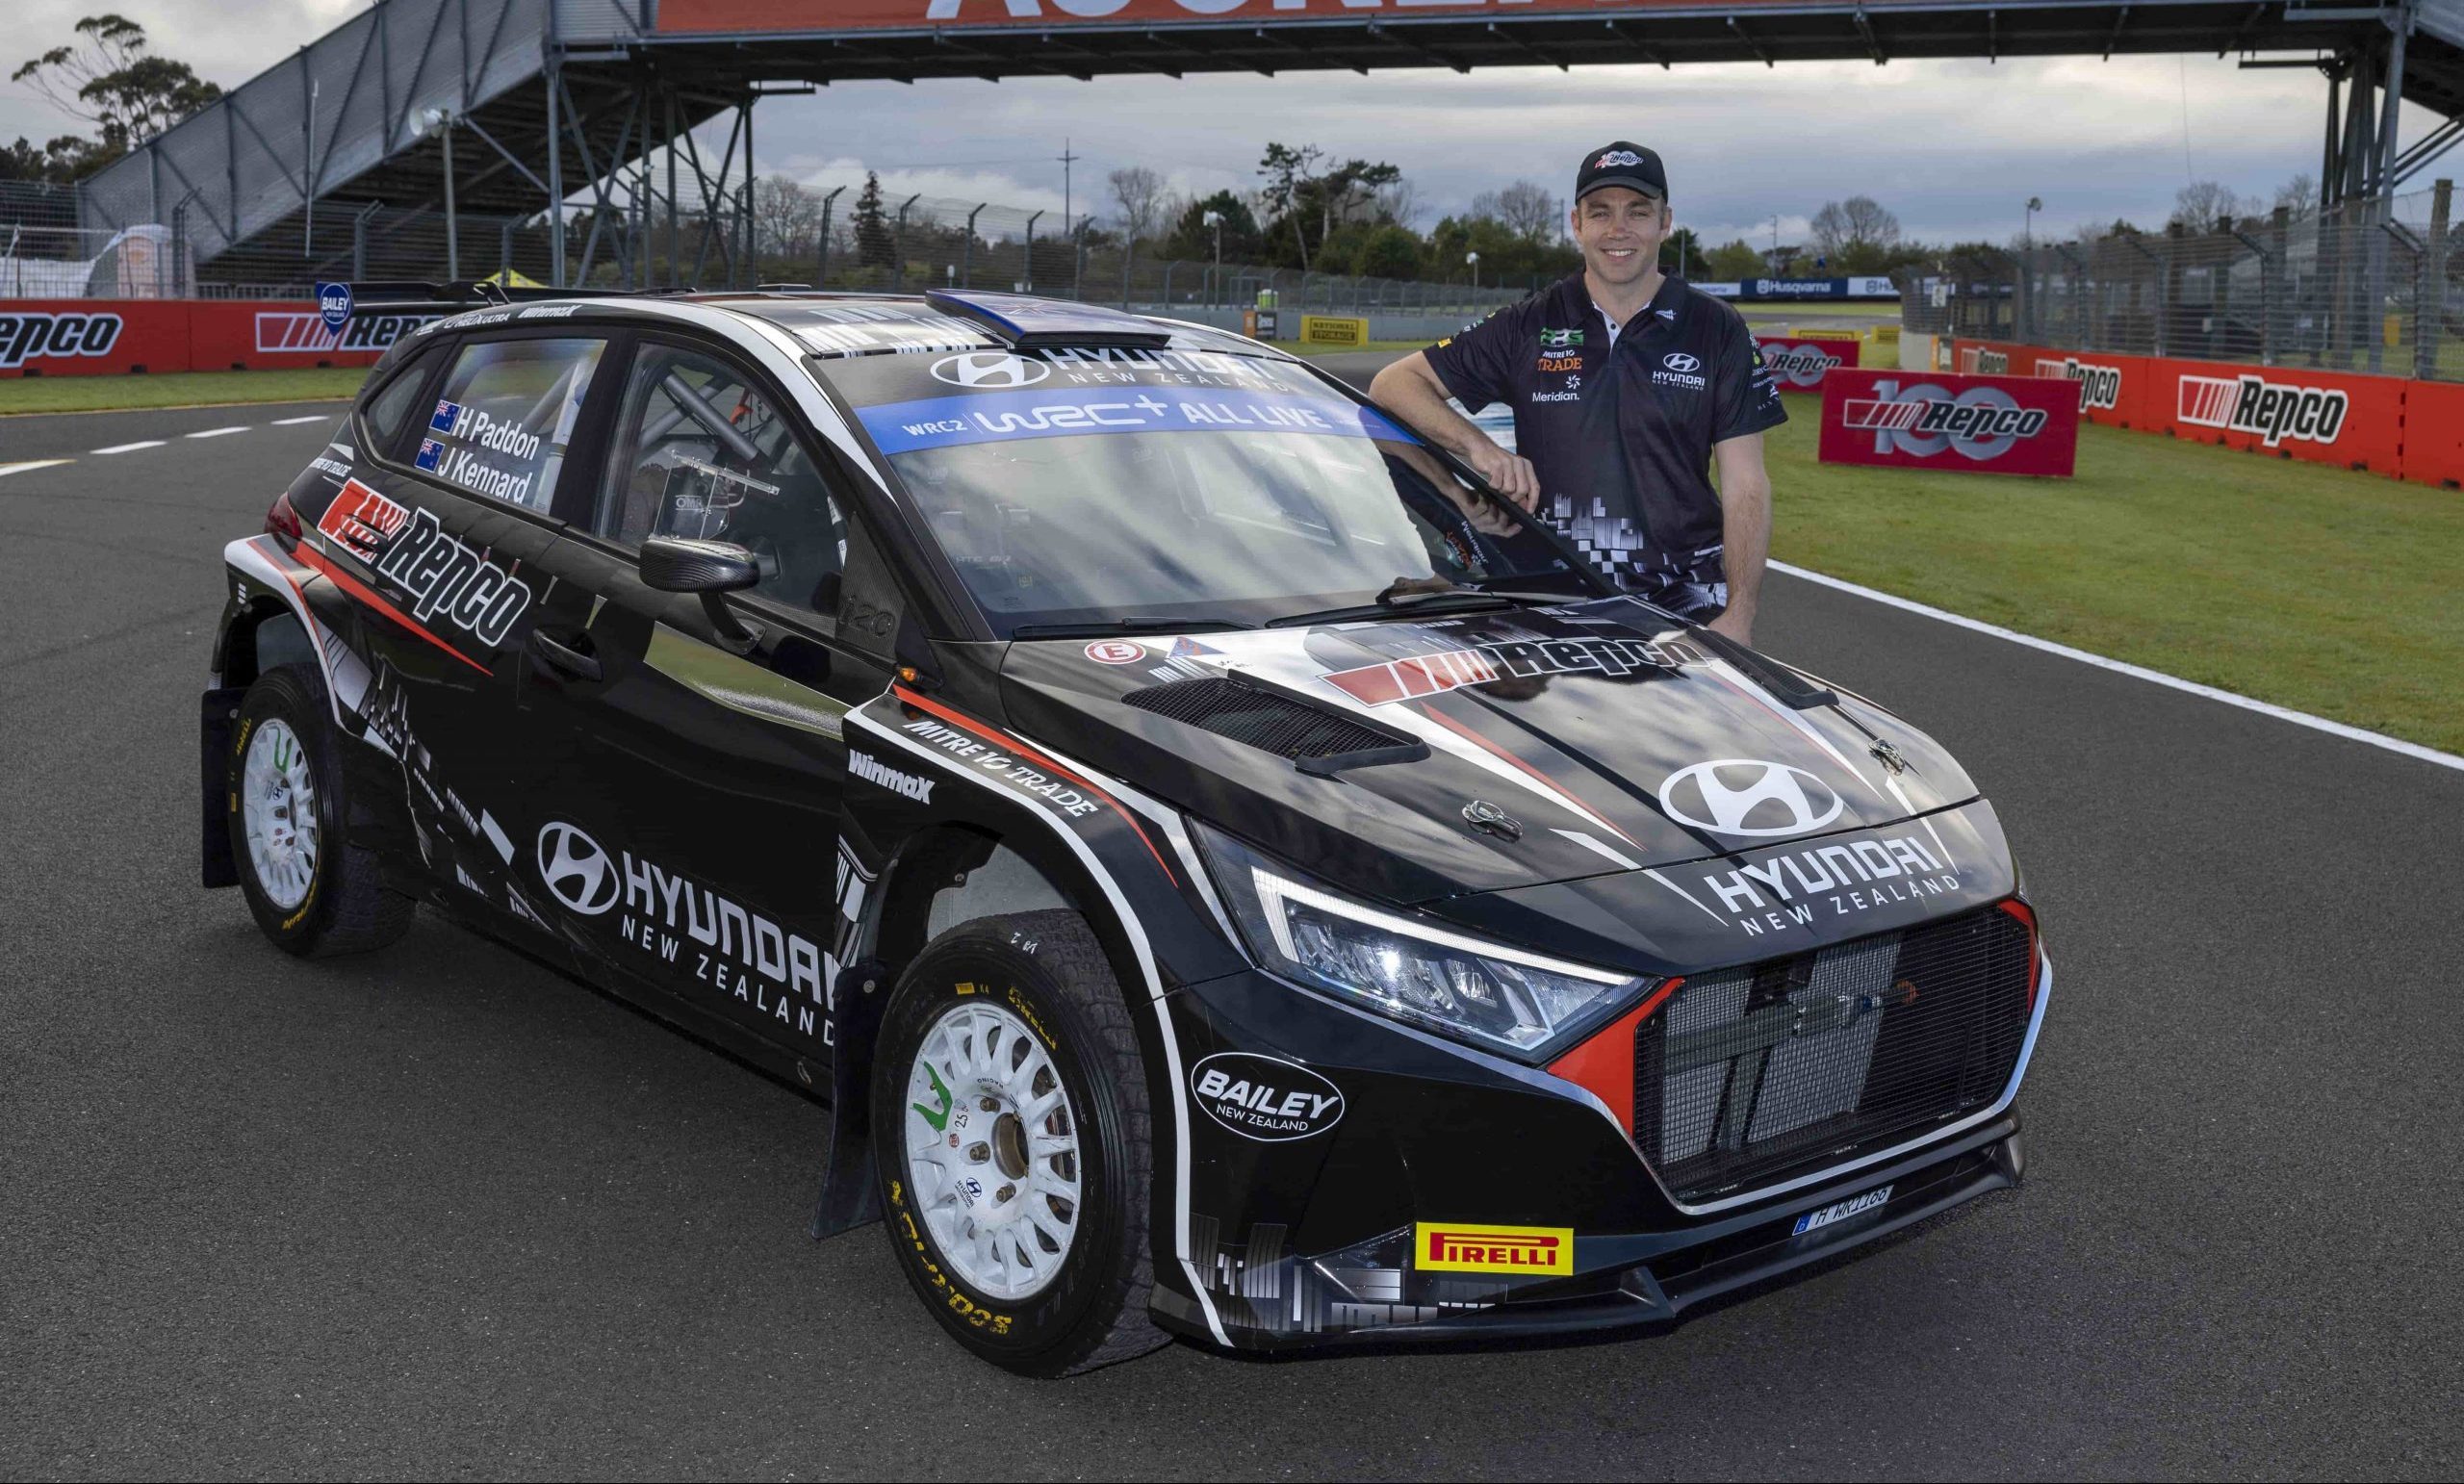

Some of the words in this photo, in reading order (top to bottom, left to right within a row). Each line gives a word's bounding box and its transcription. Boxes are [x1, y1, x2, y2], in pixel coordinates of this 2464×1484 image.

[322, 296, 349, 311] BAILEY
[1769, 280, 1832, 294] Husqvarna
[0, 312, 123, 368] epco
[1542, 350, 1565, 359] MITRE
[1040, 347, 1275, 380] HYUNDAI
[1067, 372, 1137, 384] NEW
[1155, 373, 1290, 393] ZEALAND
[1537, 357, 1583, 371] TRADE
[1653, 371, 1706, 386] HYUNDAI
[1672, 381, 1705, 391] ZEALAND
[902, 420, 968, 436] WRC2
[1178, 402, 1254, 425] ALL
[1247, 405, 1333, 429] LIVE
[1871, 379, 2022, 461] 100
[1918, 399, 2048, 440] Repco
[2229, 373, 2348, 448] Repco
[452, 406, 475, 440] H
[469, 411, 540, 461] Paddon
[438, 447, 457, 477] J
[450, 449, 533, 504] Kennard
[377, 506, 531, 648] Repco
[1102, 645, 1129, 658] E
[1477, 636, 1711, 678] Repco
[902, 720, 986, 757] MITRE
[973, 752, 1014, 770] 10
[1006, 766, 1098, 818] TRADE
[1703, 836, 1944, 913] HYUNDAI
[1740, 904, 1813, 936] NEW
[1830, 875, 1961, 915] ZEALAND
[623, 850, 835, 1012] HYUNDAI
[622, 914, 680, 962] NEW
[696, 953, 834, 1047] ZEALAND
[1196, 1068, 1339, 1119] BAILEY
[1217, 1103, 1245, 1121] NEW
[1247, 1113, 1309, 1132] ZEALAND
[957, 1180, 975, 1211] HYUNDAI
[1815, 1208, 1830, 1225] H
[1834, 1190, 1887, 1219] WR1166
[1429, 1231, 1560, 1267] PIRELLI
